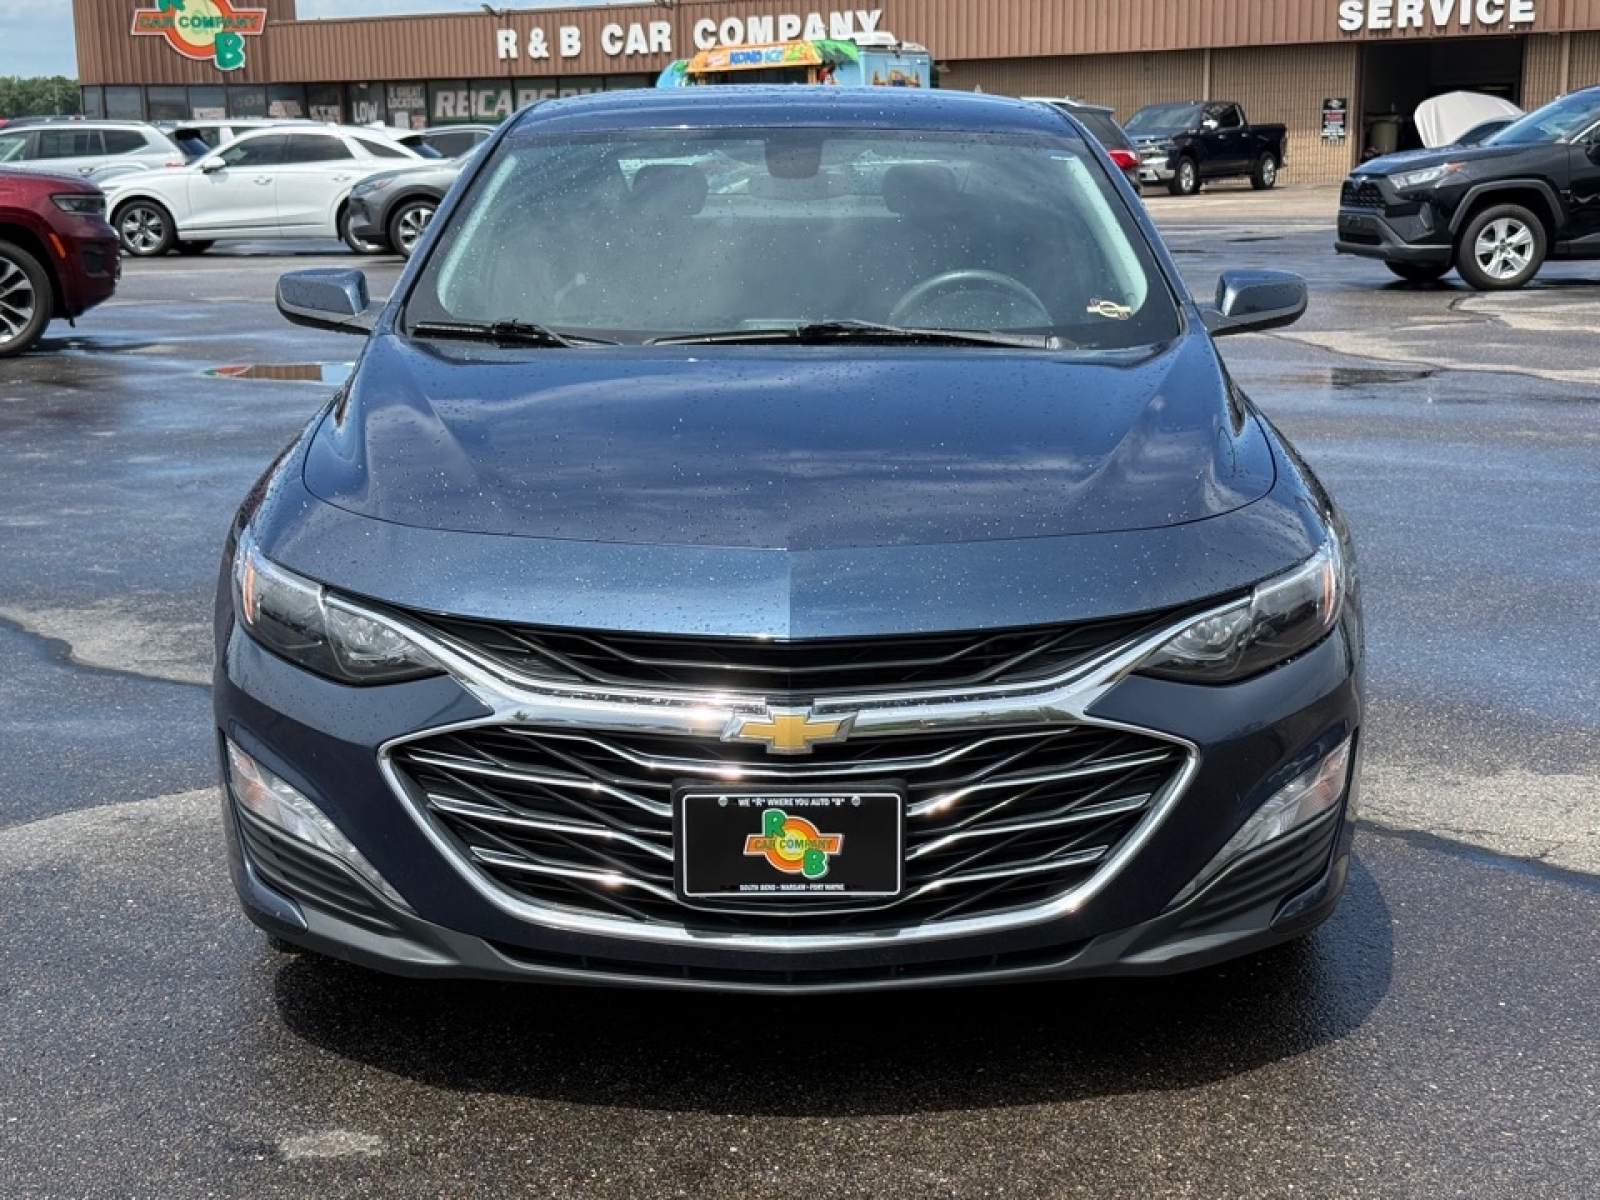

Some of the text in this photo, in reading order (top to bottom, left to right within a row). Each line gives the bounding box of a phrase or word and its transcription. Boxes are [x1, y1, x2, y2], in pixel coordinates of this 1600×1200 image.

[139, 15, 257, 29] CAR COMPANY
[1338, 0, 1536, 31] SERVICE
[497, 9, 883, 59] R & B CAR COMPANY
[215, 31, 245, 69] B
[352, 102, 378, 123] LOW
[738, 798, 750, 806] WE
[767, 798, 794, 806] WHERE
[795, 798, 809, 806] YOU
[763, 809, 787, 837] R
[755, 839, 833, 850] CAR COMPANY
[803, 848, 827, 877] B
